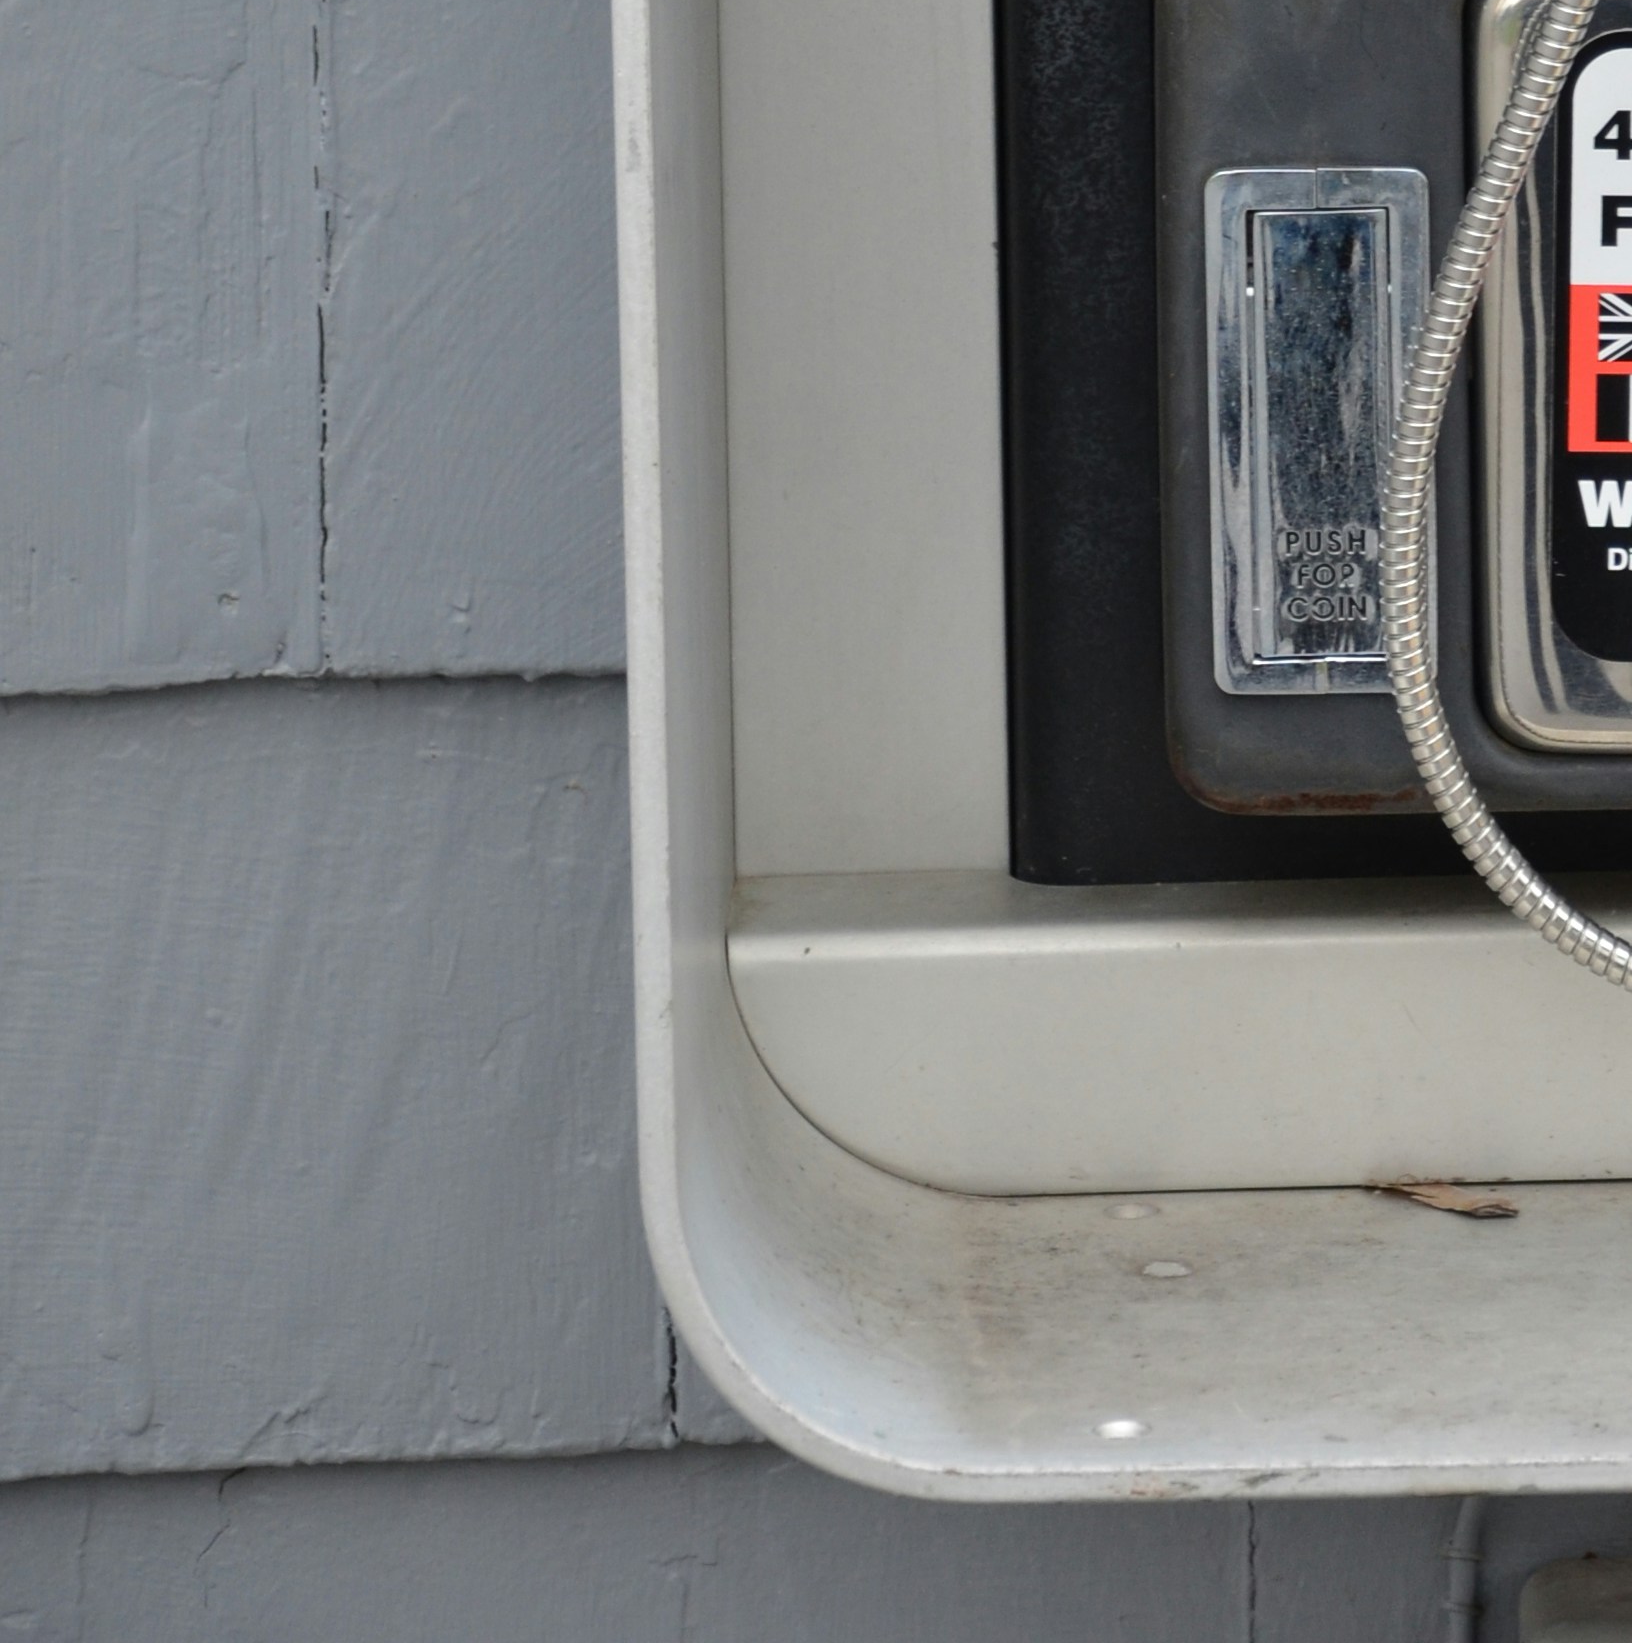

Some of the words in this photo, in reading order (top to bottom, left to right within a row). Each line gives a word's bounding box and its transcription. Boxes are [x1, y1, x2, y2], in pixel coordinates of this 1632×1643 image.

[1285, 530, 1367, 555] PUSH
[1297, 563, 1356, 588] FOR
[1286, 595, 1369, 621] COIN
